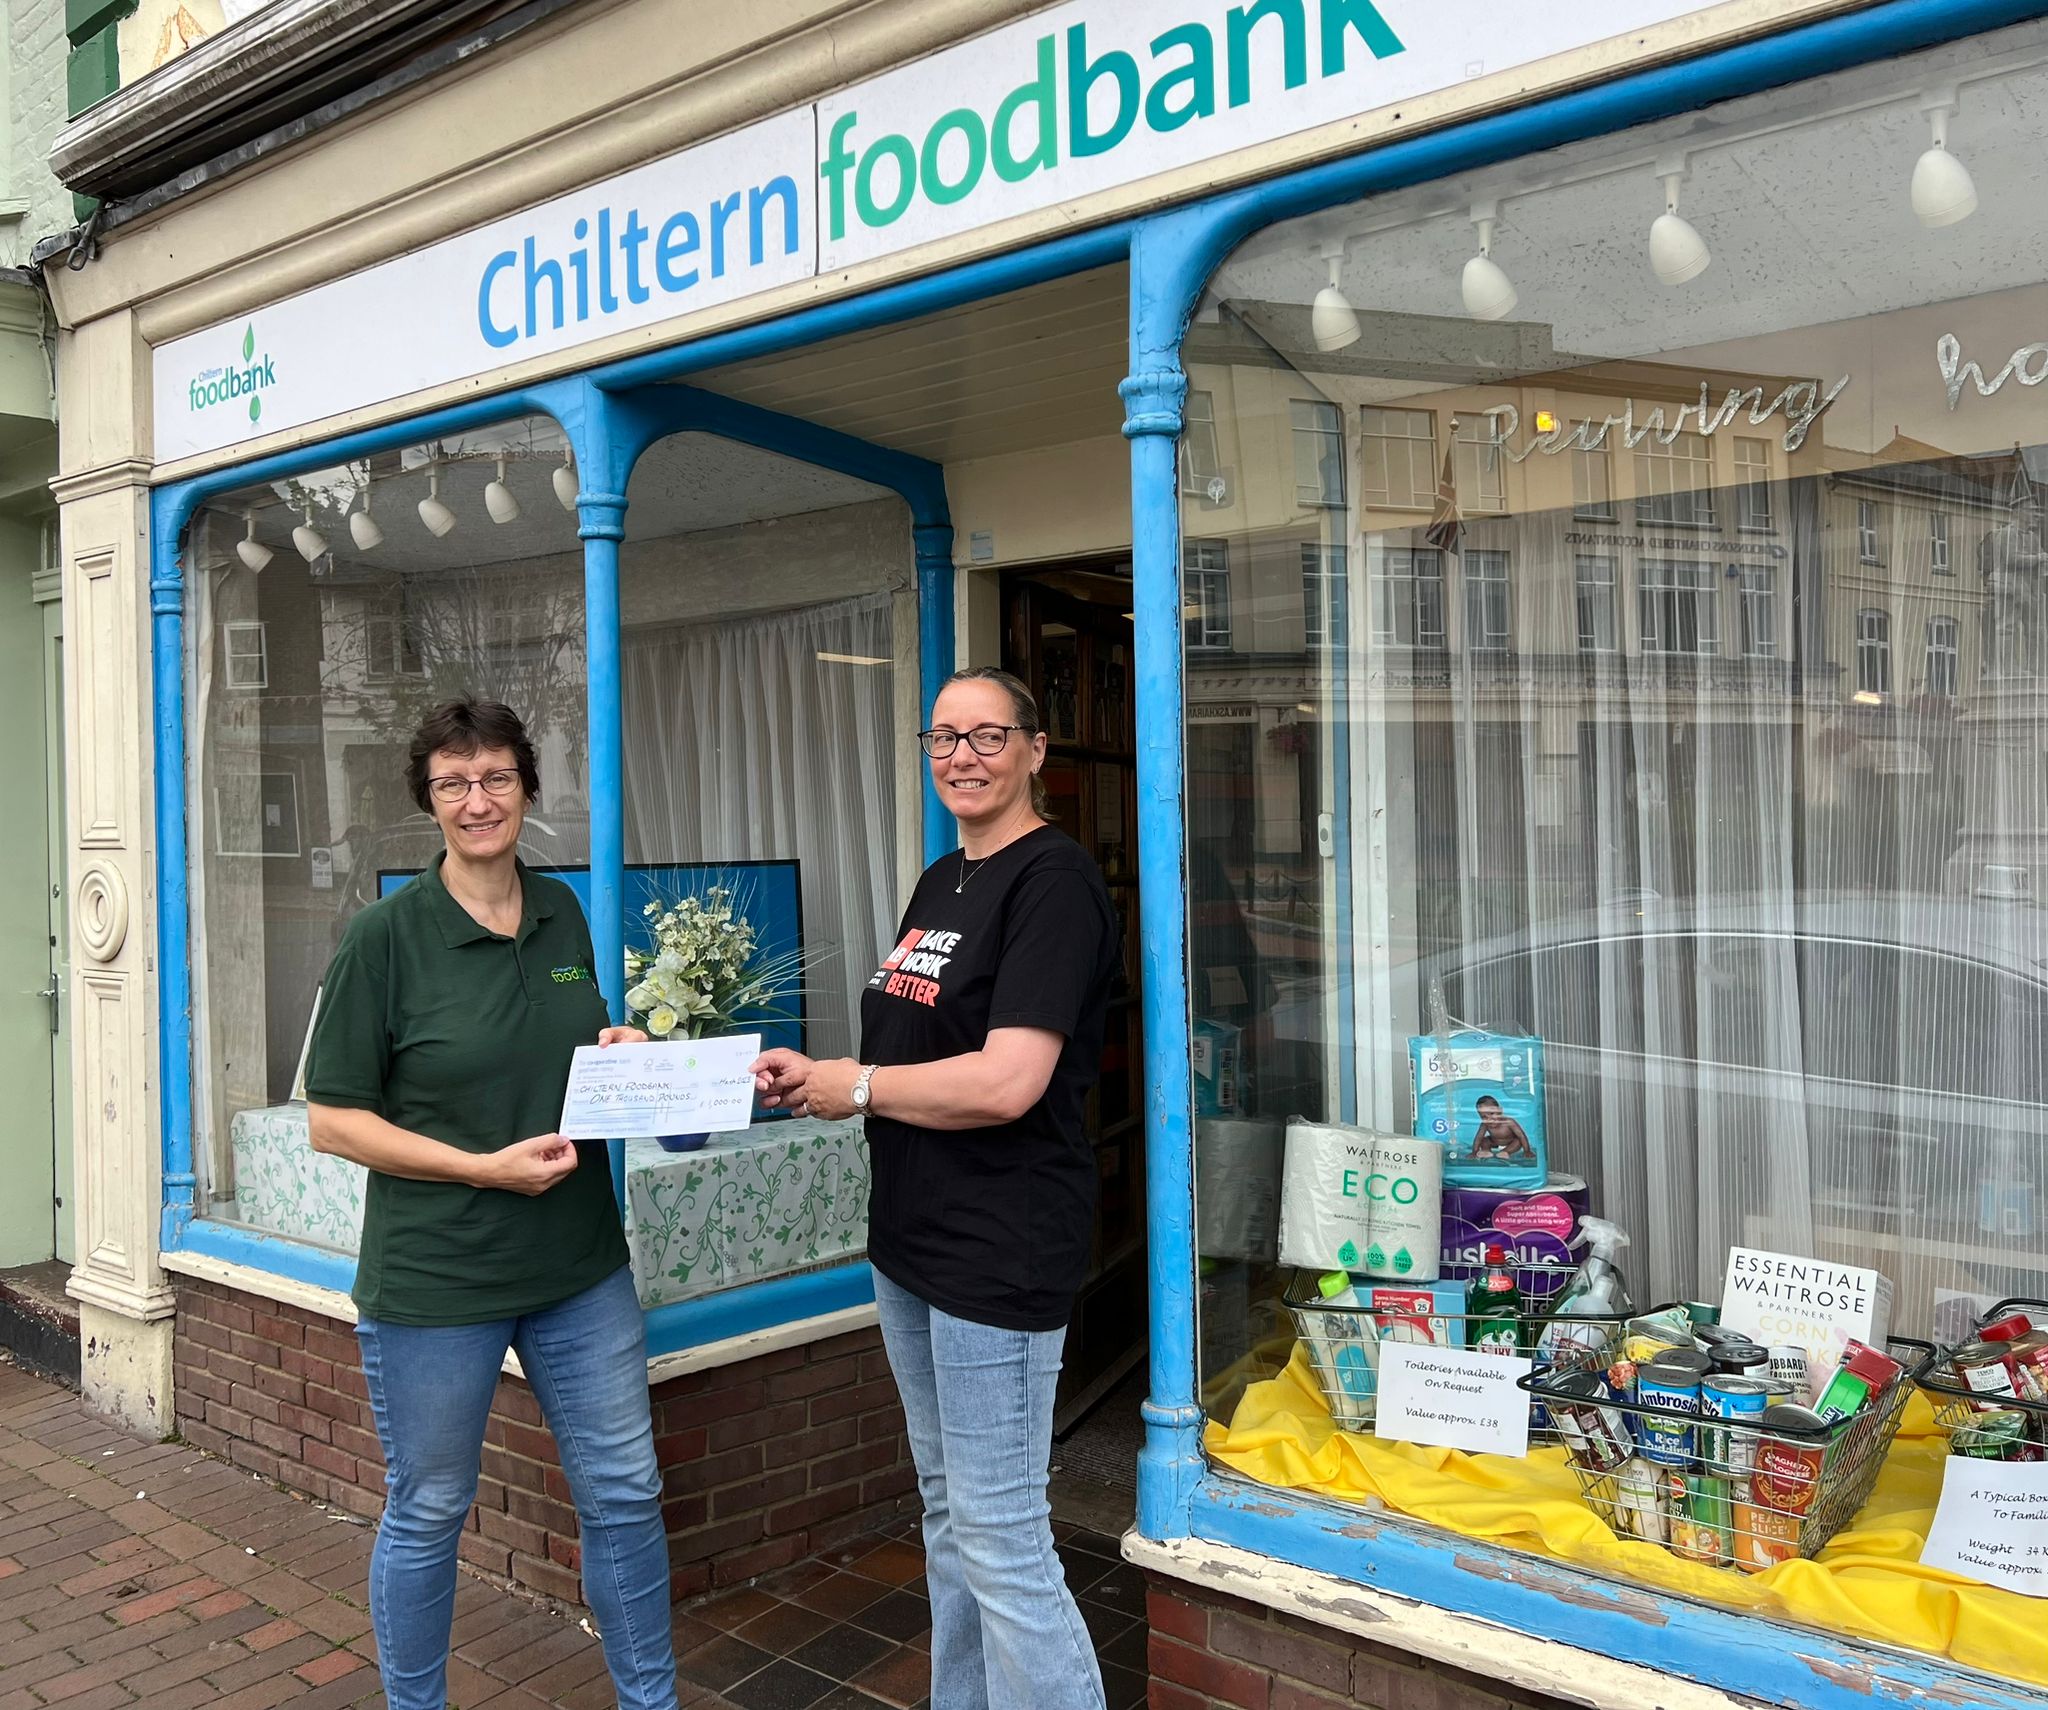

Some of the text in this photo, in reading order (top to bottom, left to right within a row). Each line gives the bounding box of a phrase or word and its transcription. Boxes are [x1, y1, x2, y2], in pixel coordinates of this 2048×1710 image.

[478, 174, 799, 348] Chiltern
[189, 353, 276, 411] foodbank
[899, 951, 952, 979] WORK
[884, 971, 940, 1007] BETTER
[1436, 1120, 1445, 1132] 5
[1345, 1145, 1418, 1165] WAITROSE
[1342, 1169, 1419, 1205] ECO
[1367, 1252, 1385, 1260] 100%
[1735, 1254, 1867, 1293] ESSENTIAL
[1733, 1275, 1866, 1314] WAITROSE
[1417, 1303, 1428, 1312] 25
[1769, 1302, 1833, 1321] PARTNERS
[1759, 1315, 1828, 1343] CORN
[1404, 1360, 1507, 1381] Toiletries Available
[1424, 1378, 1485, 1394] On Request
[1640, 1392, 1698, 1414] Ambrosia
[1405, 1407, 1499, 1428] Value approx. £38
[1655, 1432, 1680, 1445] Rice
[1766, 1451, 1811, 1472] SPAGHETTI
[1970, 1490, 2048, 1503] A Typical Box
[1993, 1509, 2008, 1519] To
[1969, 1538, 2015, 1555] Weight
[2025, 1546, 2040, 1556] 34
[1957, 1551, 2043, 1576] Value approx.
